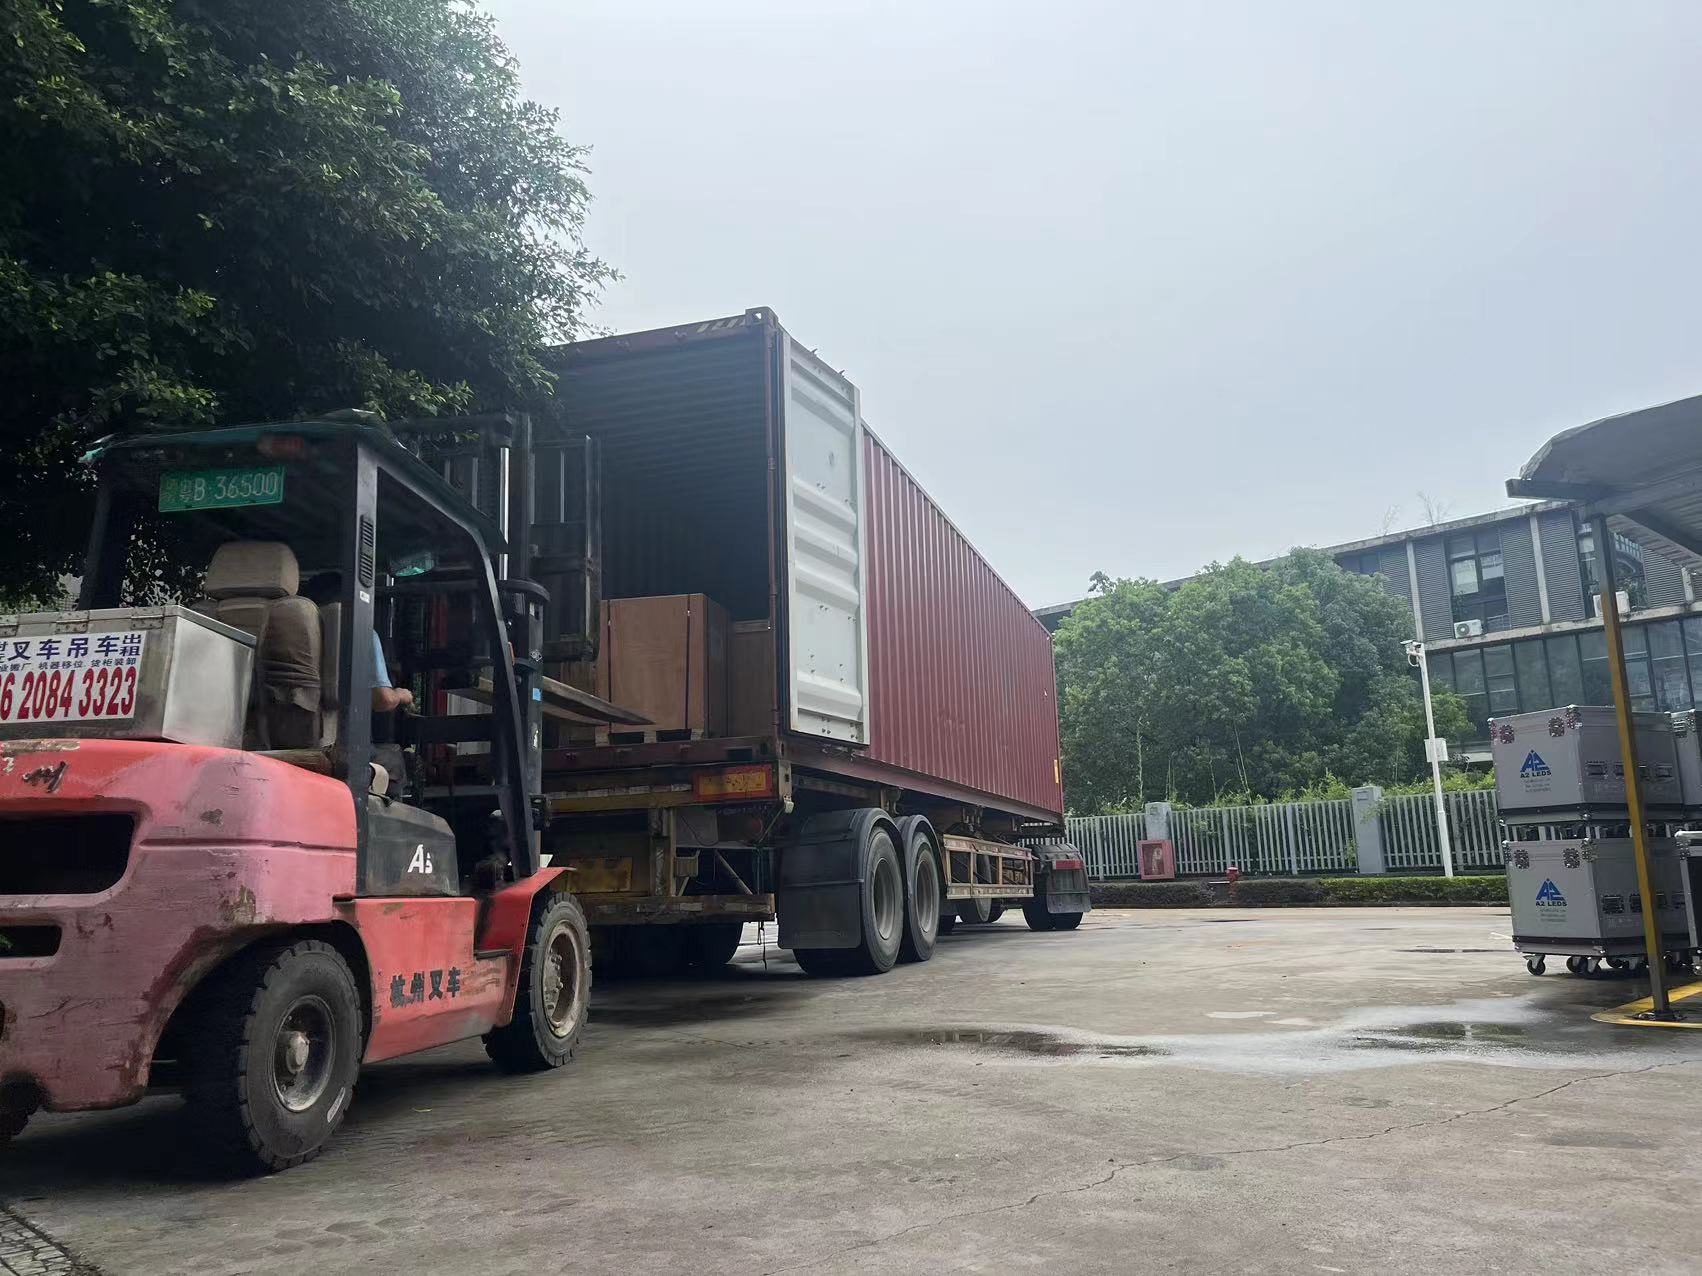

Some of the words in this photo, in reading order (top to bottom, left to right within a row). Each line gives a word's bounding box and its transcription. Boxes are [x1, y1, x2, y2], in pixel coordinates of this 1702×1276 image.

[0, 672, 15, 720] 6
[17, 669, 76, 719] 2084
[78, 666, 137, 717] 3323
